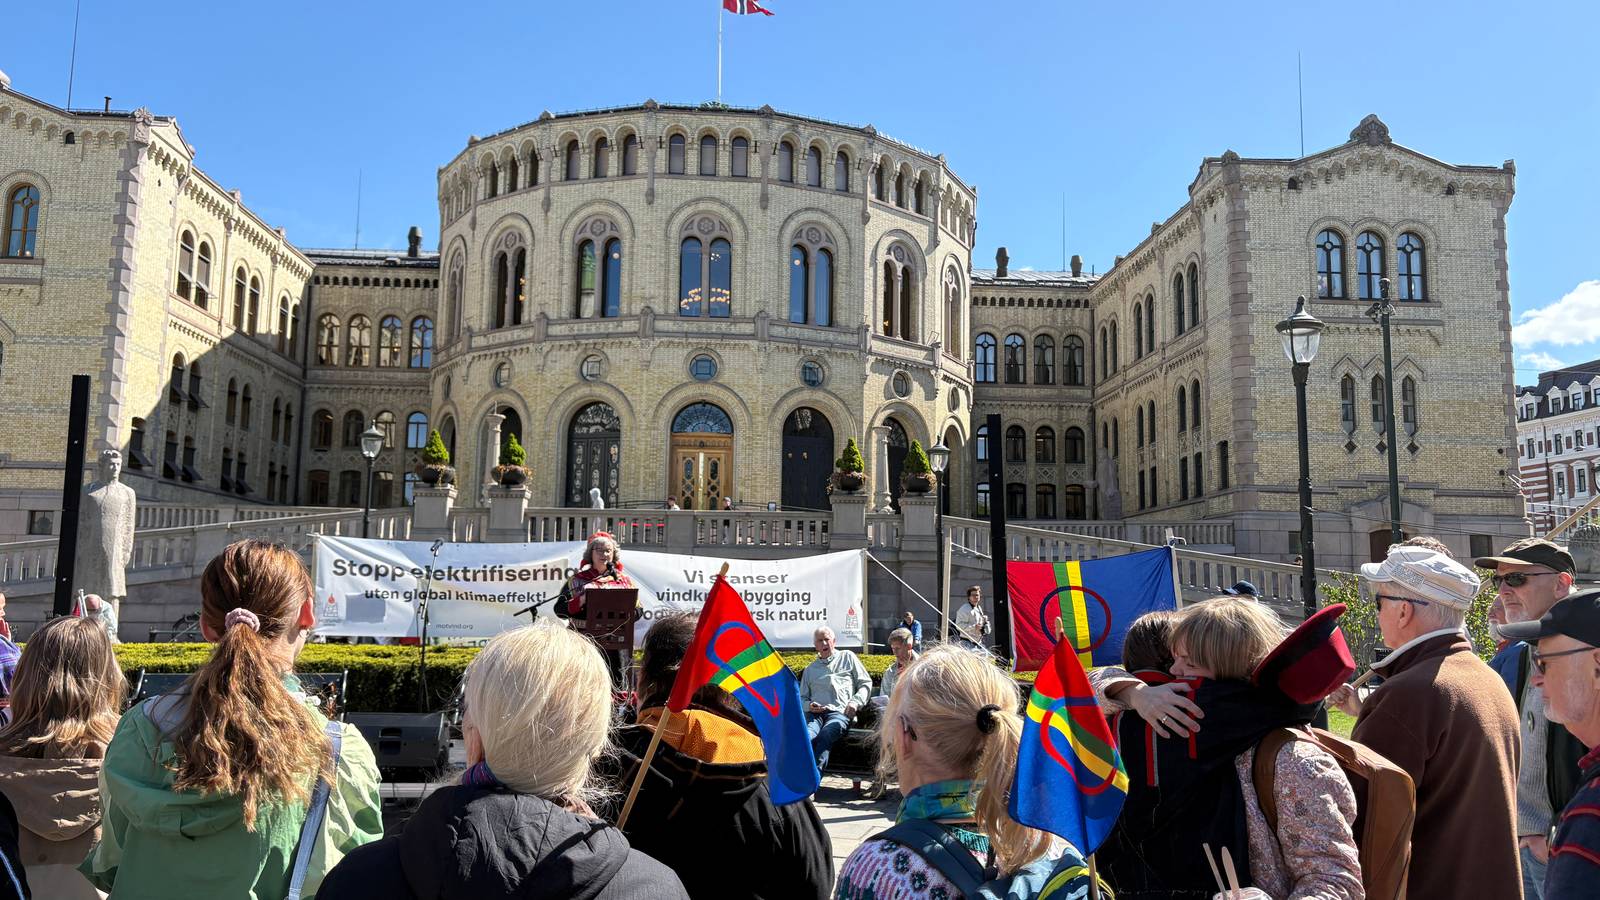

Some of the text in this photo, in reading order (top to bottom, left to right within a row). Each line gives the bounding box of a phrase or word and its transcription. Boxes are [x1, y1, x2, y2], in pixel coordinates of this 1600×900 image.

[332, 558, 405, 581] Stopp
[683, 569, 789, 585] Vi sanser
[364, 588, 547, 603] uten global klimaeffekt!
[779, 608, 828, 621] natur!
